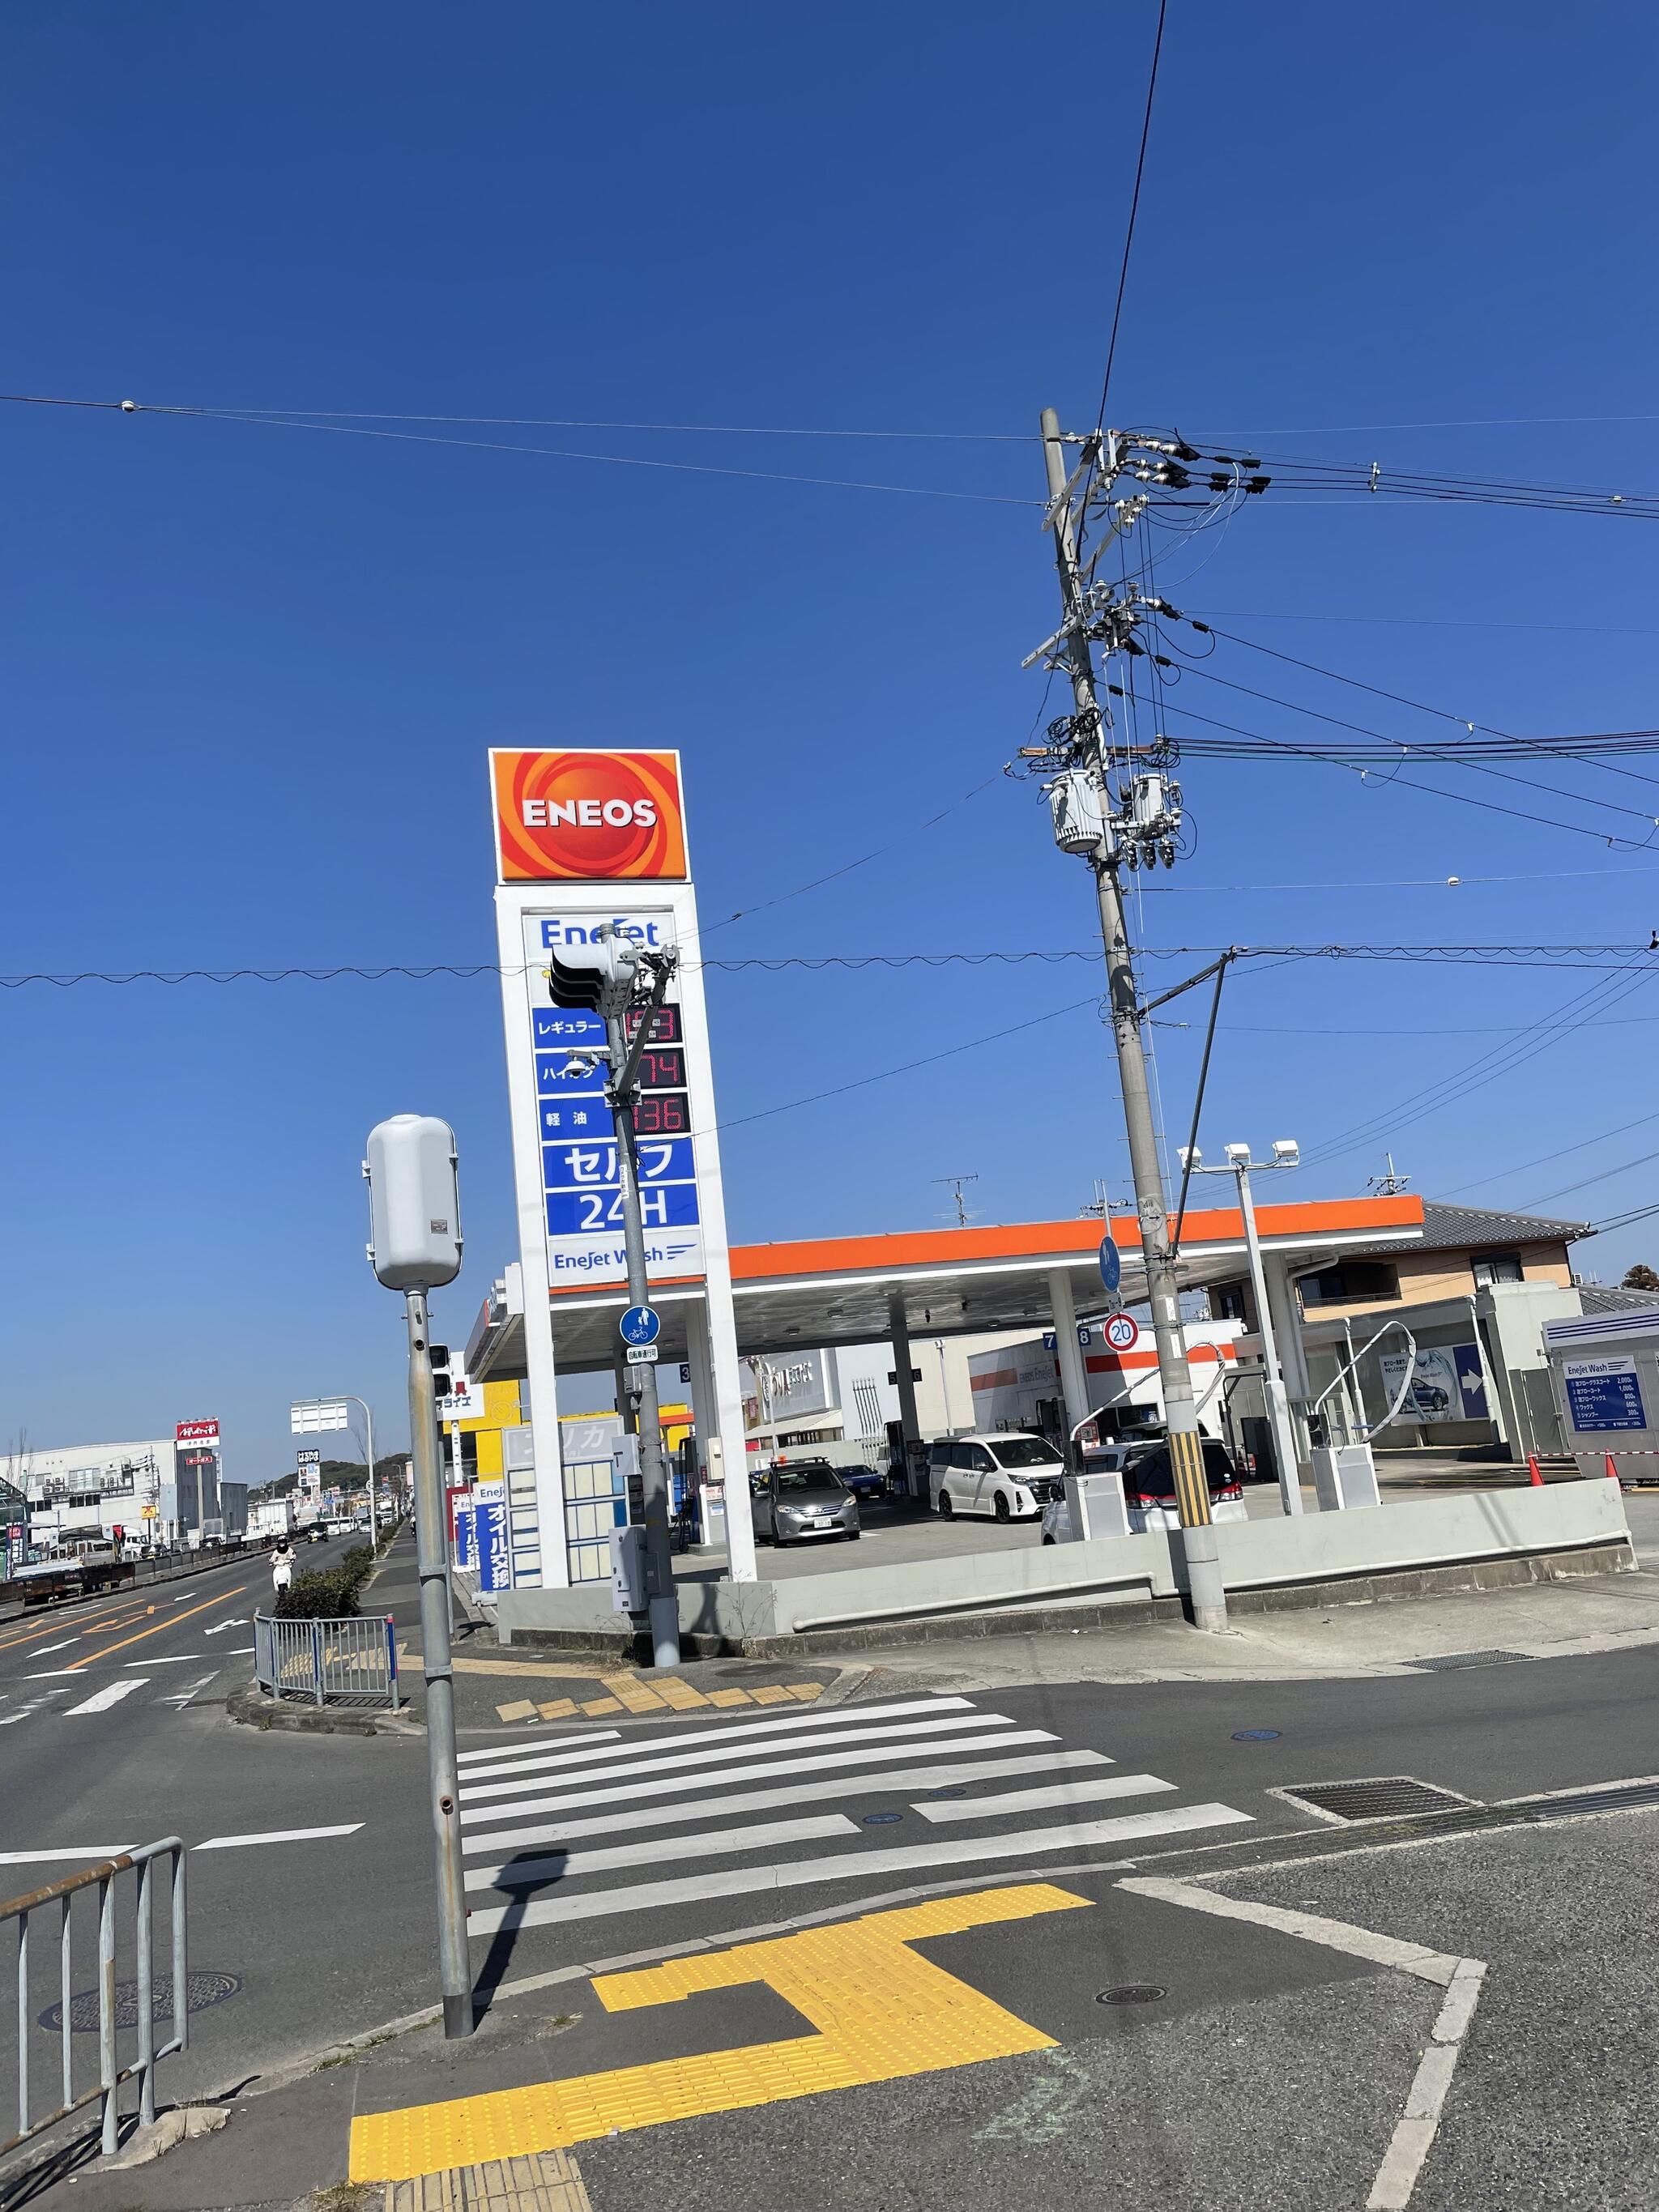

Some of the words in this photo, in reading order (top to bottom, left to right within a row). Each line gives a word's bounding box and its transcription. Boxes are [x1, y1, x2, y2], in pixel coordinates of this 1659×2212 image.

[522, 799, 658, 828] ENEOS
[538, 1021, 601, 1035] レギュラー
[543, 1066, 594, 1080] ハイク
[640, 1055, 679, 1083] 74
[634, 1098, 682, 1132] 136
[554, 1251, 610, 1270] Enejet
[613, 1247, 663, 1264] Wsh
[1079, 1330, 1089, 1344] 8
[1111, 1323, 1132, 1342] 20
[1044, 1334, 1054, 1348] 7
[681, 1366, 690, 1380] 3
[913, 1370, 921, 1381] 6
[1567, 1365, 1589, 1375] Enejet
[1588, 1363, 1608, 1373] Wash
[889, 1374, 896, 1383] 5
[297, 1450, 319, 1464] はるやま
